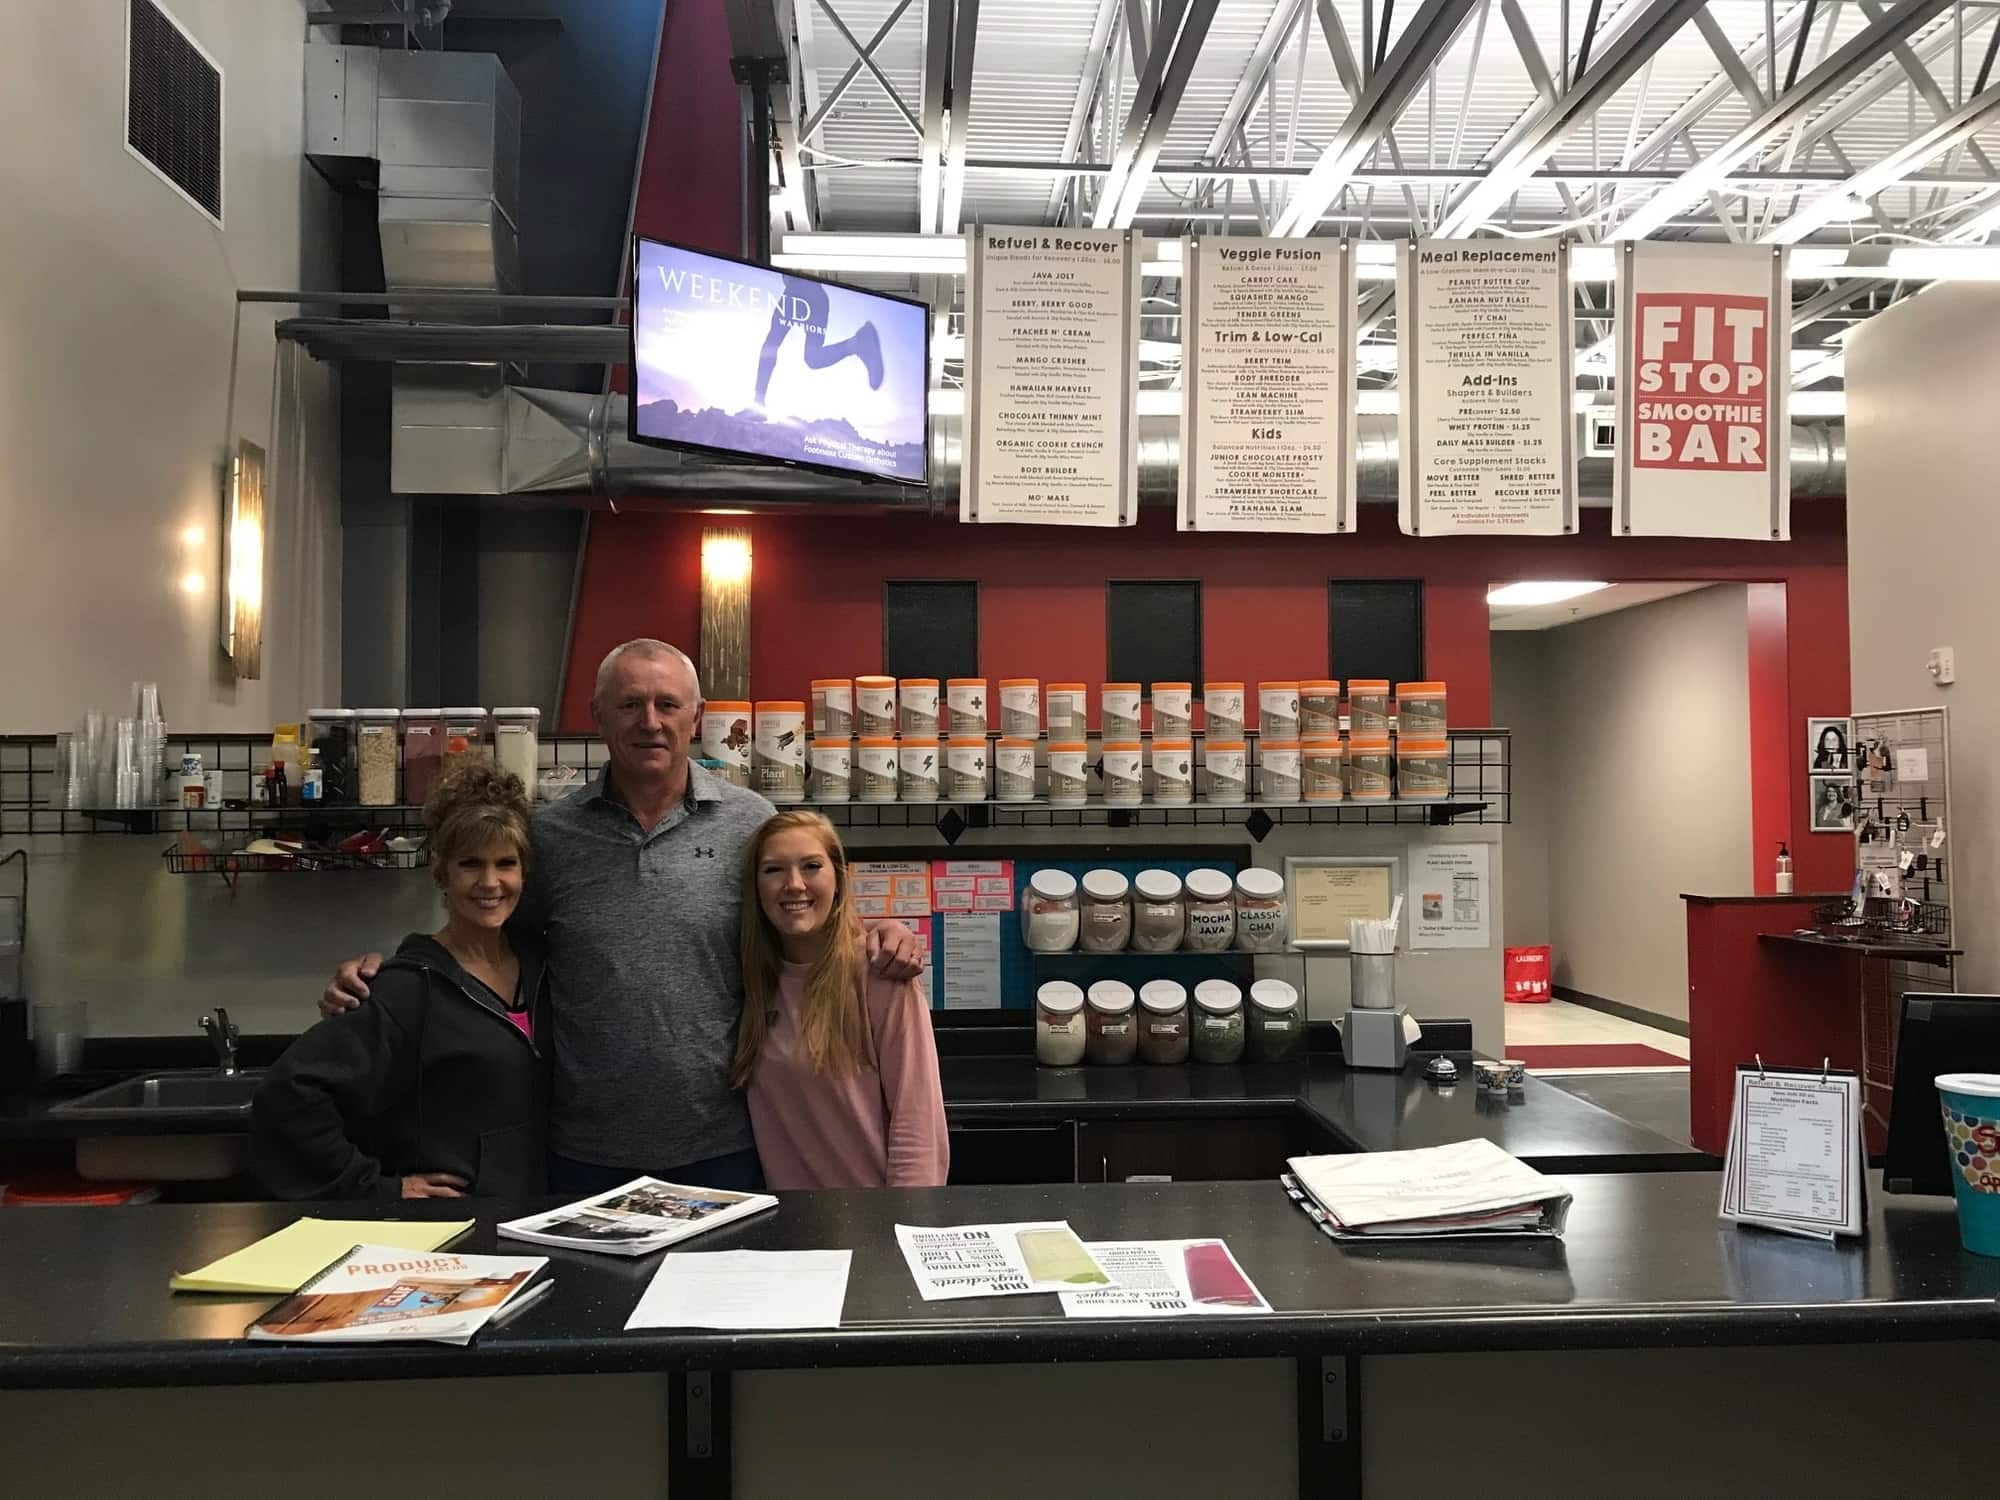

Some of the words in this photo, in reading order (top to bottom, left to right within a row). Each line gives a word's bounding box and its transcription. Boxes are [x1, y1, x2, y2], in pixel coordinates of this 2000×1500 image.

[989, 237, 1037, 249] Refuel
[1041, 238, 1050, 249] &
[1056, 239, 1118, 252] Recover
[1220, 248, 1271, 262] Veggie
[1276, 249, 1321, 260] Fusion
[1420, 252, 1457, 263] Meal
[1462, 250, 1556, 263] Replacement
[657, 266, 812, 322] WEEKEND
[1215, 331, 1247, 343] Trim
[1252, 331, 1260, 343] &
[1265, 332, 1323, 343] Low-Cal
[1642, 307, 1764, 363] FIT
[1462, 375, 1518, 386] Add-Ins
[1639, 362, 1763, 395] STOP
[1056, 385, 1091, 393] HARVEST
[1447, 389, 1485, 398] Shapers
[999, 412, 1046, 420] CHOCOLATE
[1638, 404, 1762, 423] SMOOTHIE
[1252, 428, 1282, 439] Kids
[1639, 423, 1763, 465] BAR
[1458, 457, 1512, 467] Supplement
[1516, 457, 1546, 465] Stacks
[760, 769, 784, 778] Plant
[1192, 914, 1231, 925] MOCHA
[1240, 910, 1281, 920] CLASSIC
[1199, 925, 1225, 935] JAVA
[1249, 921, 1275, 932] CHAI
[1748, 1079, 1773, 1087] Refuel
[1784, 1081, 1816, 1090] Recover
[963, 1231, 989, 1239] NO
[346, 1256, 463, 1276] PRODUCT
[930, 1274, 1024, 1288] ingredients
[990, 1282, 1029, 1291] OUR
[1075, 1290, 1123, 1300] veggies
[1144, 1290, 1180, 1299] fruits
[1150, 1301, 1187, 1309] OUR
